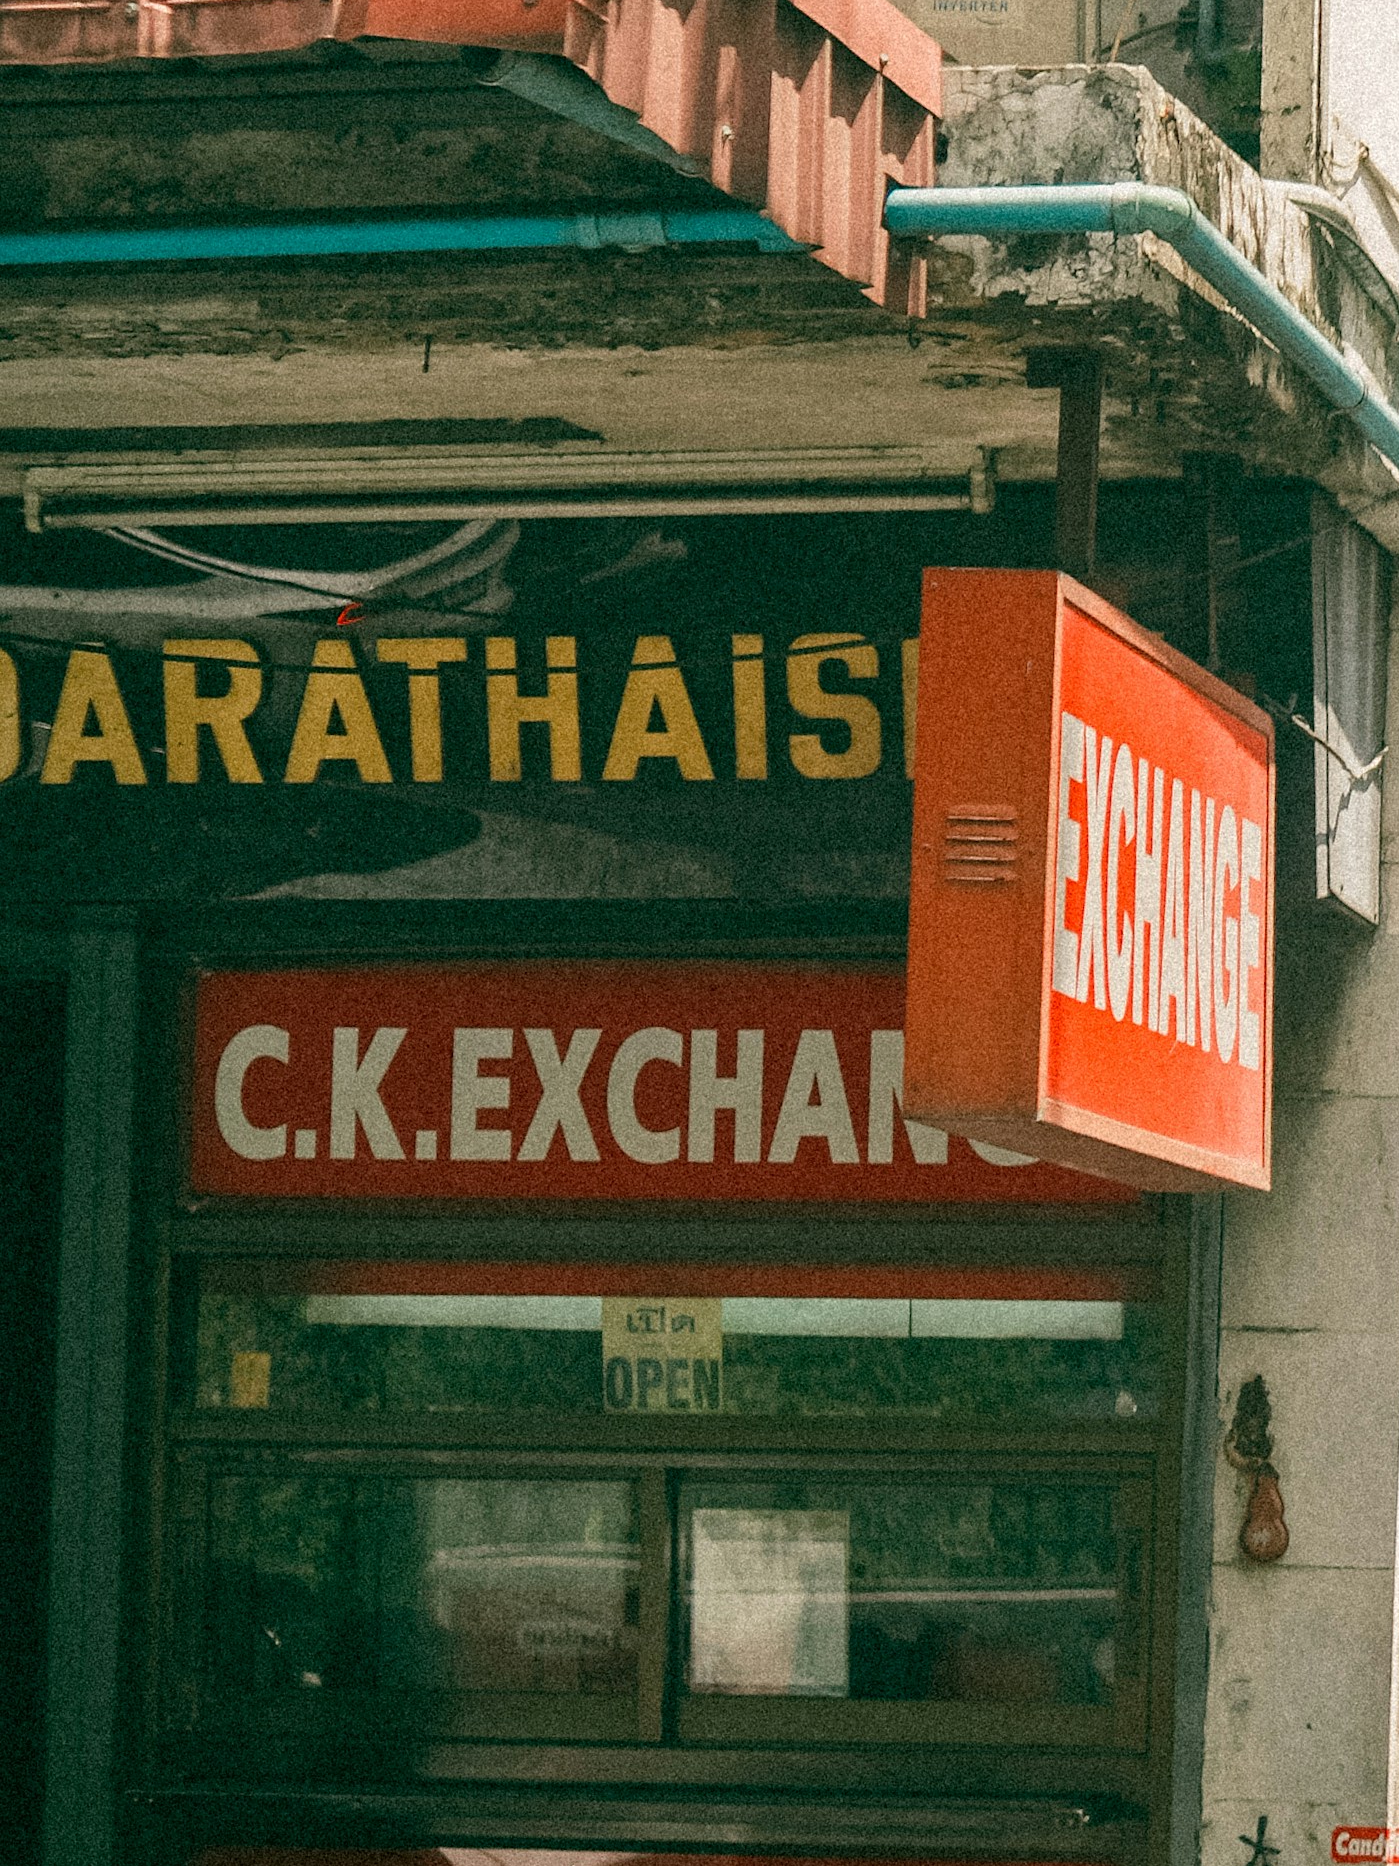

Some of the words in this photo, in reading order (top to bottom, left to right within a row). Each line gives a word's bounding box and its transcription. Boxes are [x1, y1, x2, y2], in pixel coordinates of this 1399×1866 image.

[0, 630, 918, 786] ARATHAIS
[1052, 711, 1263, 1072] EXCHANGE
[214, 1023, 1040, 1167] C.K.EXCHAN
[606, 1356, 720, 1410] OPEN
